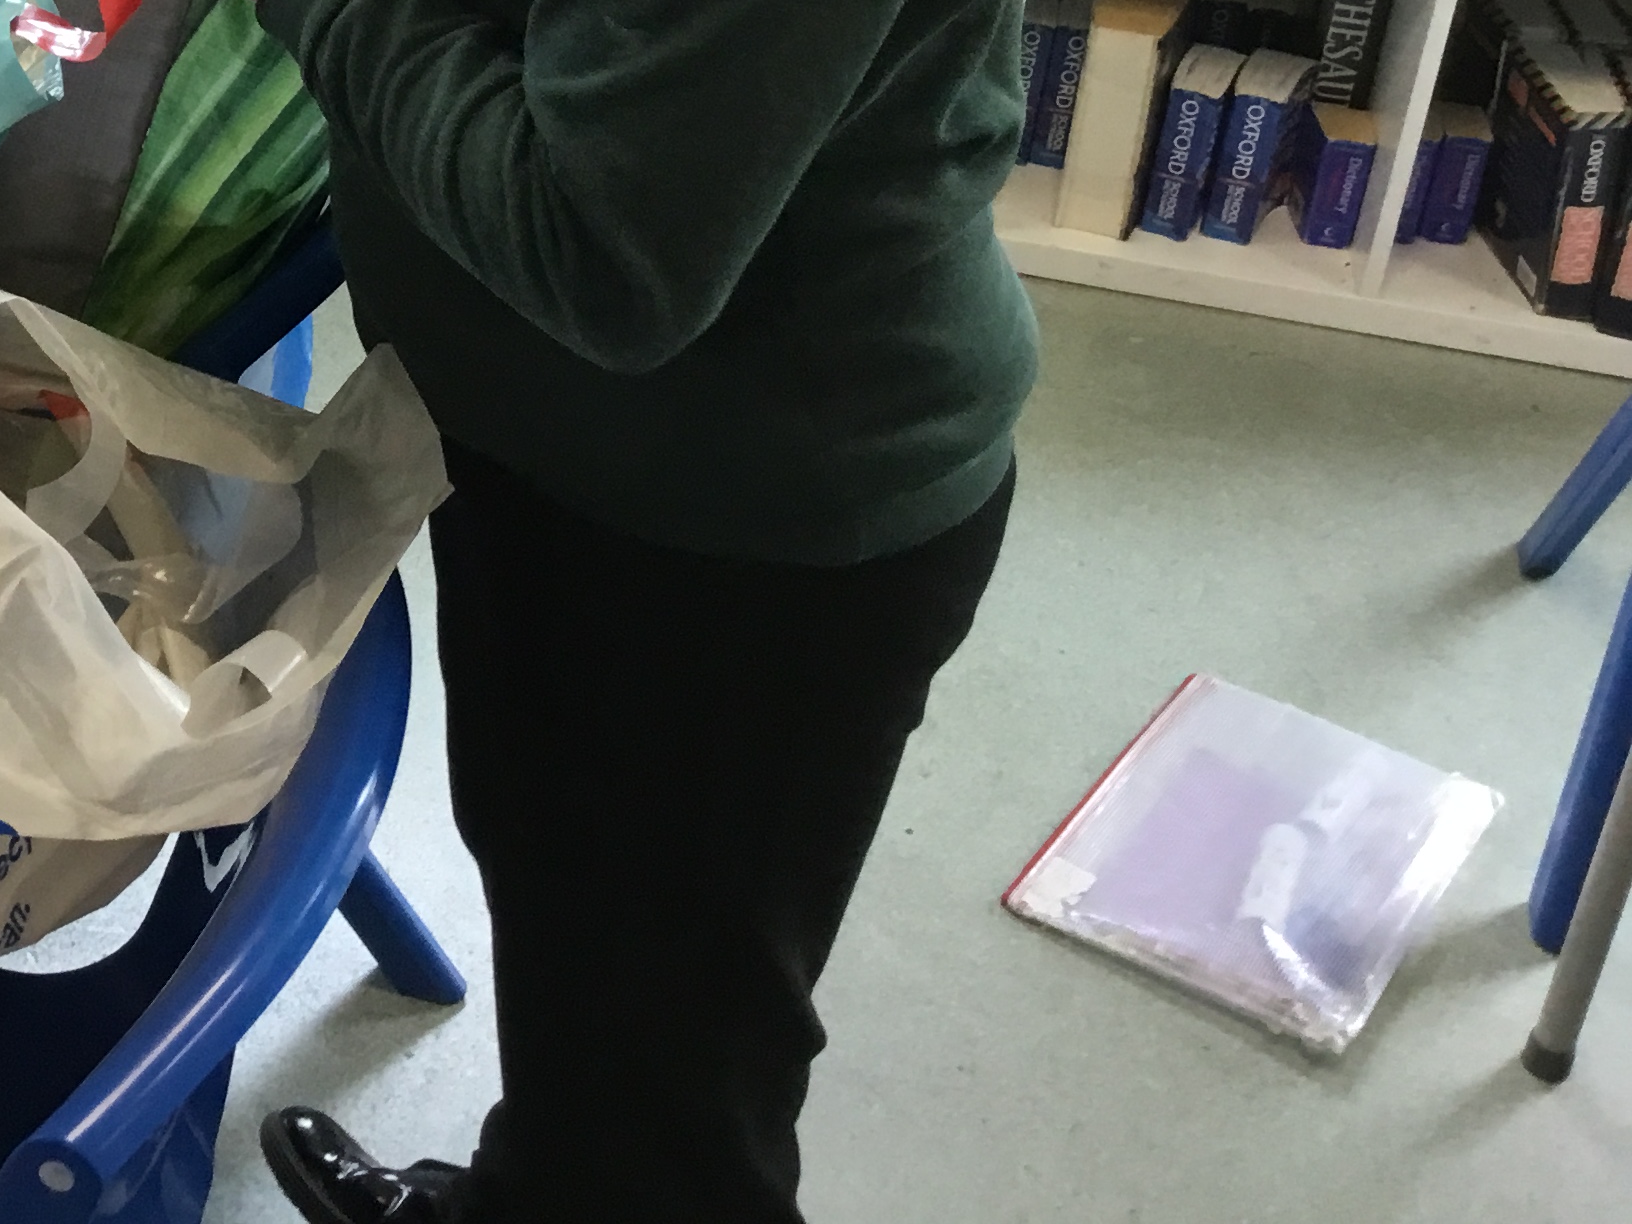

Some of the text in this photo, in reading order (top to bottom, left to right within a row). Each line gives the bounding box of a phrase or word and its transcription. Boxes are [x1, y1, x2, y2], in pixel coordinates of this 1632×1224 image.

[1055, 35, 1085, 109] OXFORD
[1167, 99, 1200, 175] OXFORD
[1226, 104, 1265, 225] OXFORD SCHOOL
[1581, 139, 1607, 204] OXFORD
[1336, 156, 1363, 214] Dictionary
[1452, 153, 1481, 211] Dictionary
